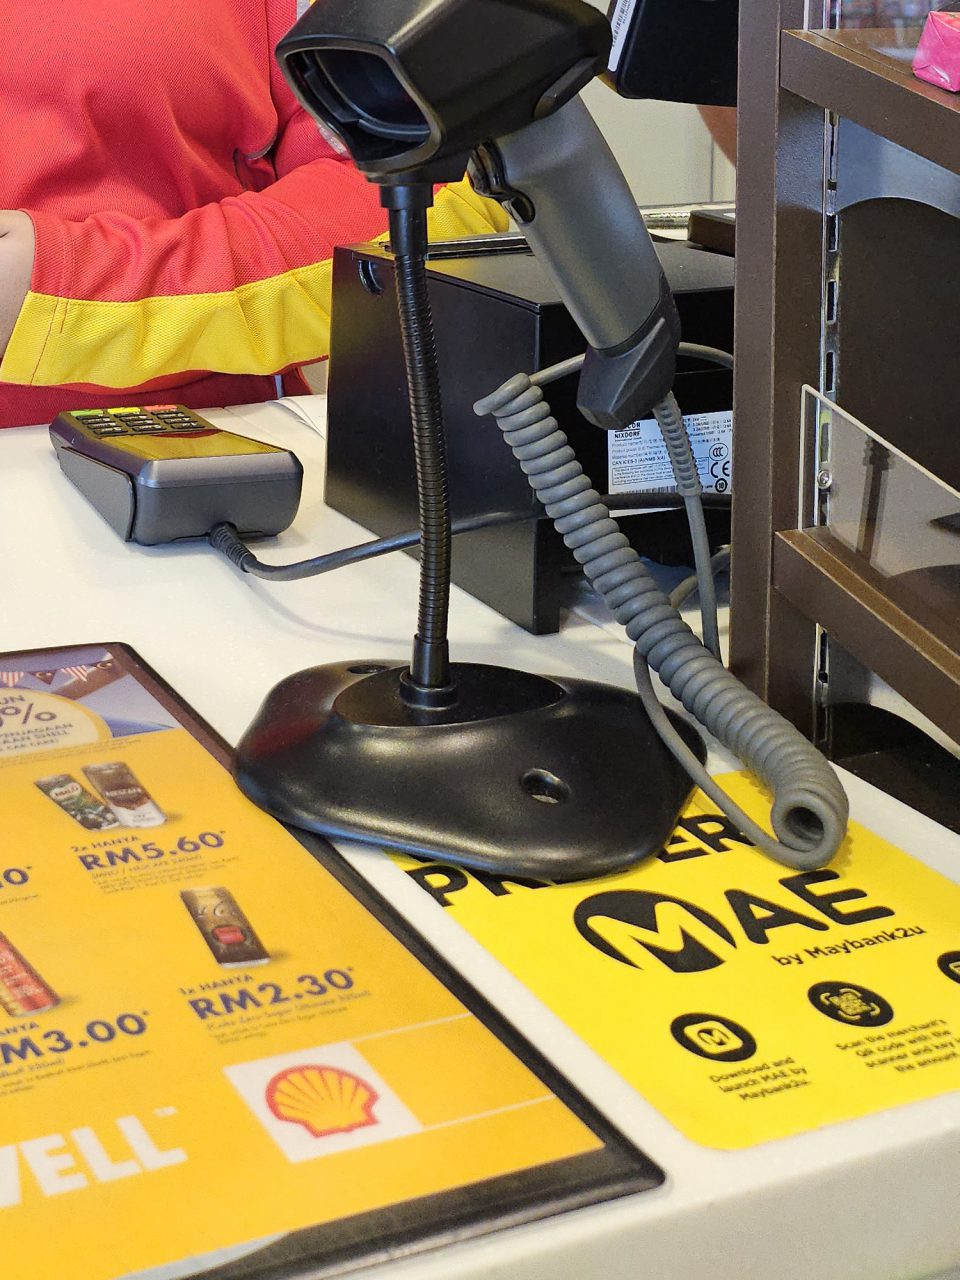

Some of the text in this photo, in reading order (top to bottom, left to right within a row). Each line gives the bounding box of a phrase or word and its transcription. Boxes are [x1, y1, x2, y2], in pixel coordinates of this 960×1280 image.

[90, 834, 139, 850] HANYA
[771, 925, 927, 966] by Maybank2u
[200, 974, 254, 991] HANYA
[835, 1041, 863, 1051] Scan
[865, 1033, 886, 1043] the
[877, 1042, 905, 1054] code
[908, 1035, 936, 1045] with
[937, 1029, 952, 1038] the
[911, 1047, 933, 1057] and
[934, 1041, 955, 1052] key
[708, 1057, 795, 1083] Download and
[719, 1066, 807, 1093] launch MAE by
